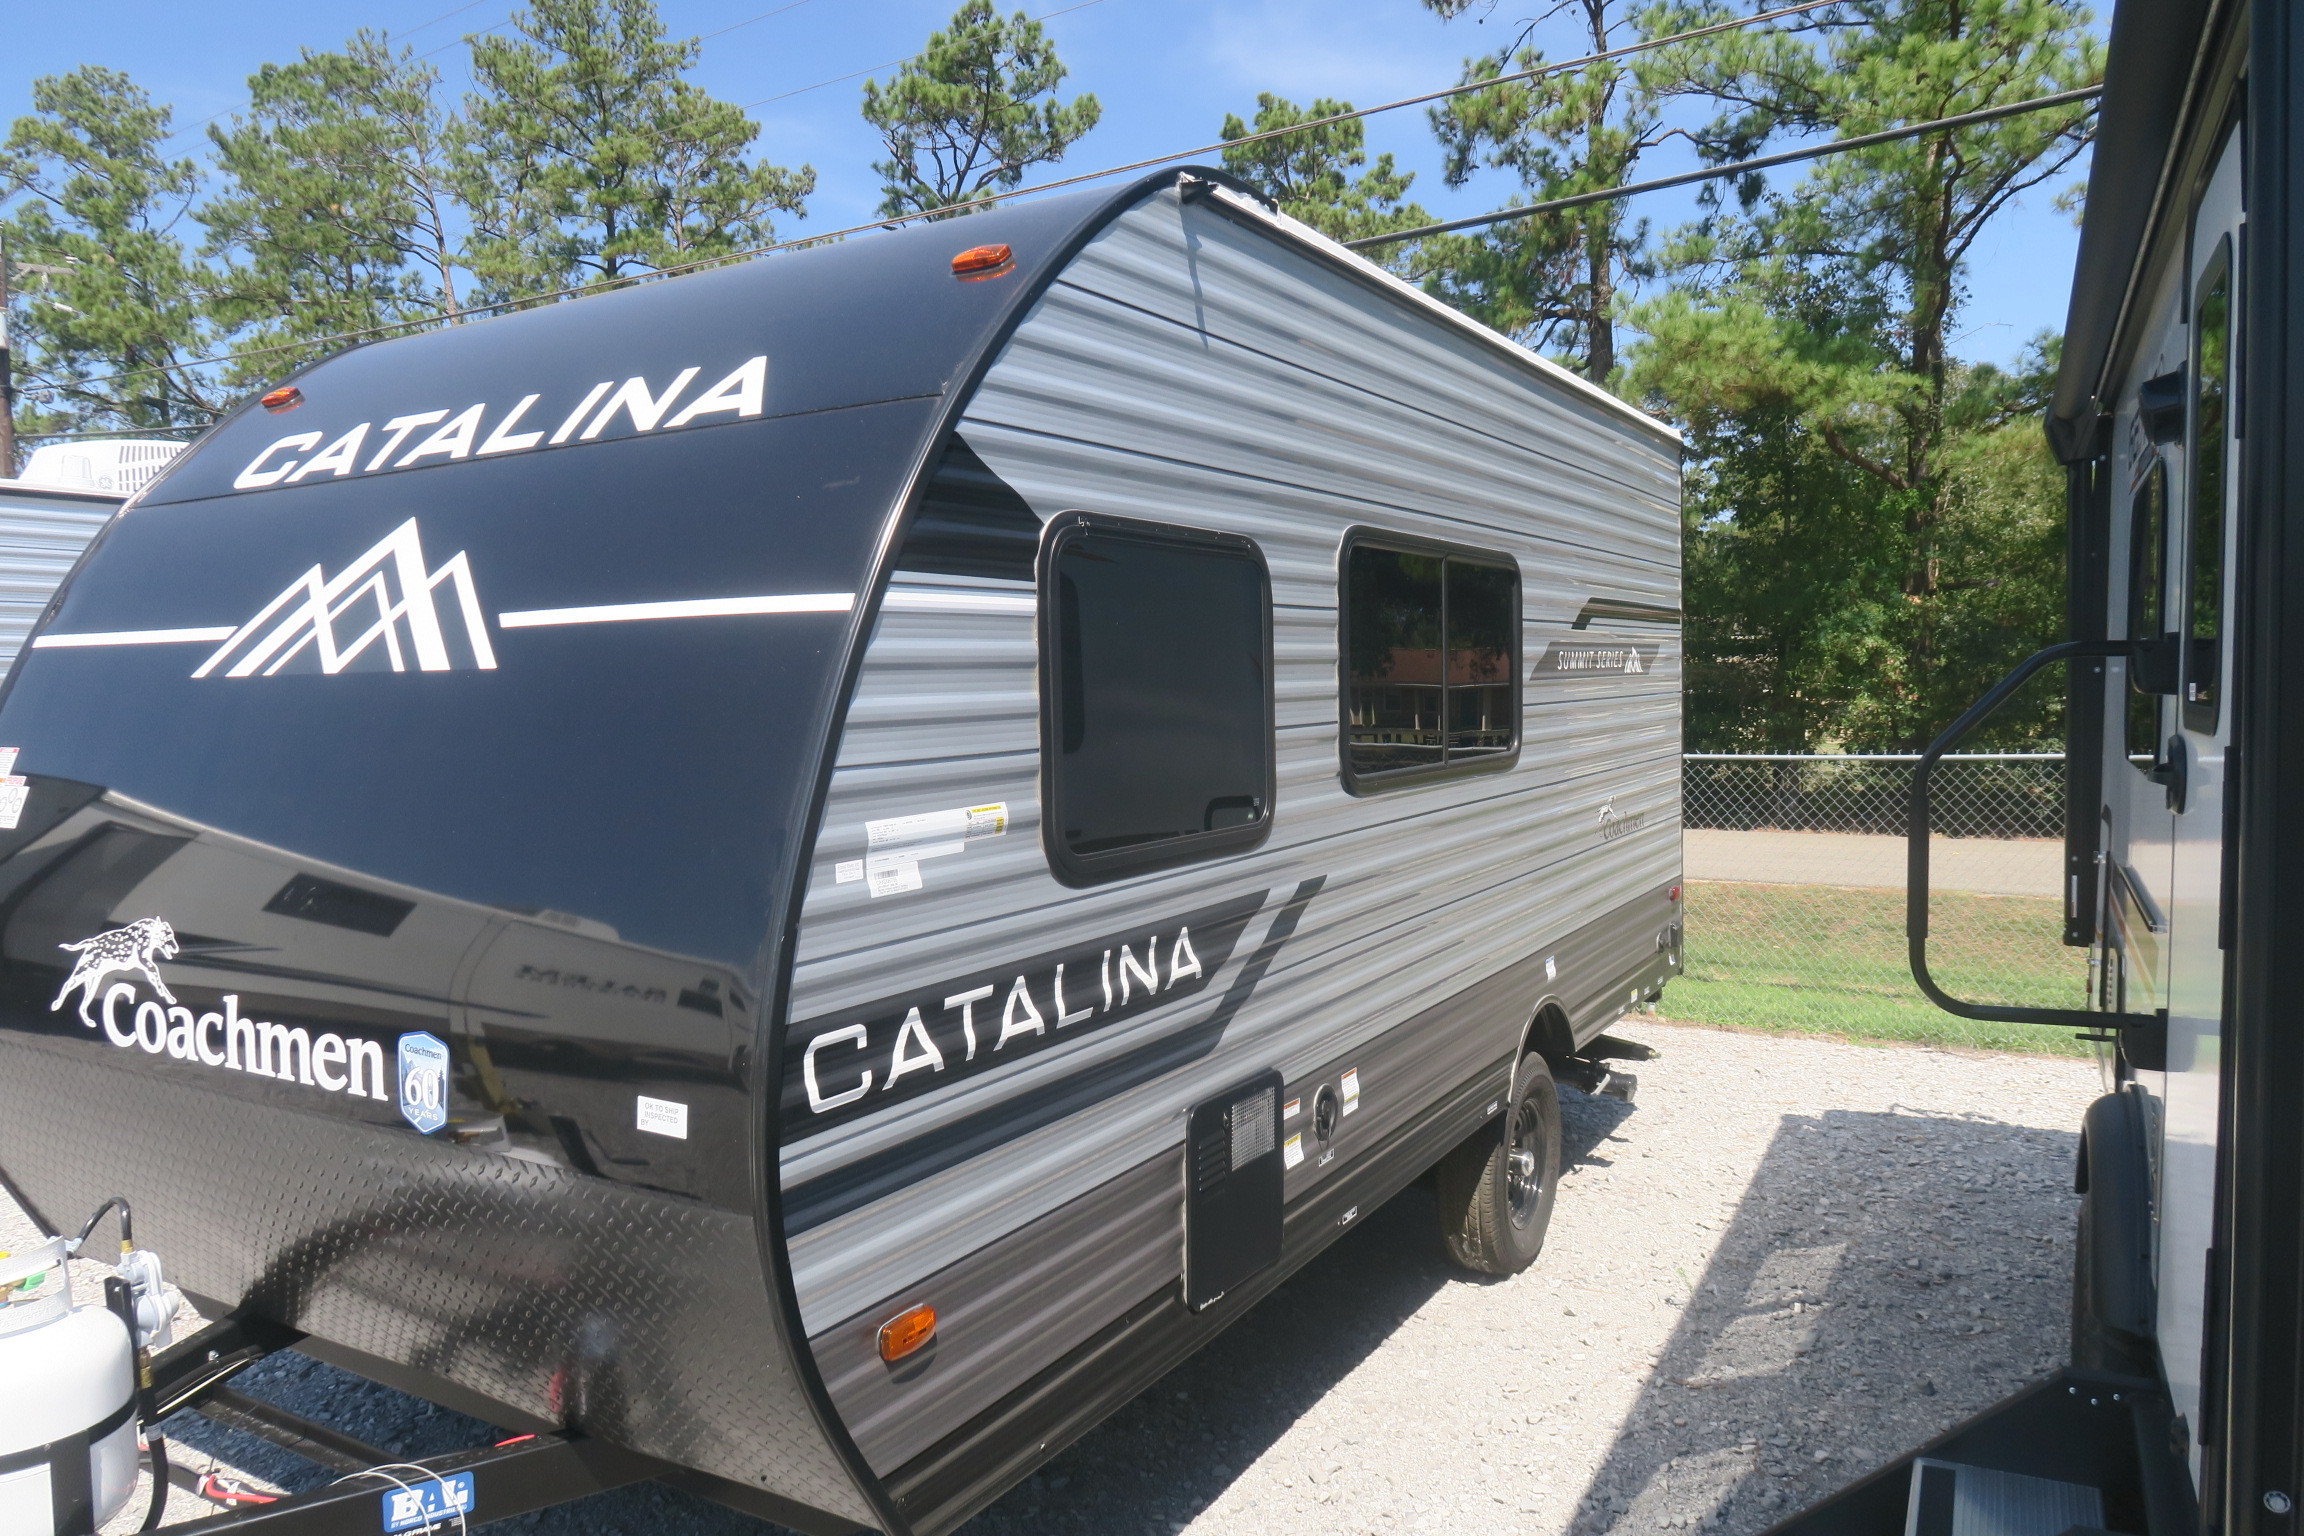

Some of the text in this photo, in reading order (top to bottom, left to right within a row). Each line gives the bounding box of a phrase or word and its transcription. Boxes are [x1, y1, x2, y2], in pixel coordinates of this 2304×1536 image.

[233, 355, 768, 490] CATALINA
[1557, 650, 1624, 670] SUMMIT SERIES
[803, 926, 1203, 1114] CATALINA
[102, 982, 389, 1102] Coachmen
[404, 1043, 442, 1060] Coachmen
[405, 1066, 440, 1110] 60
[408, 1107, 438, 1121] YEARS
[644, 1111, 678, 1124] INSPECTED
[645, 1102, 653, 1110] OK
[664, 1106, 679, 1115] SHIP
